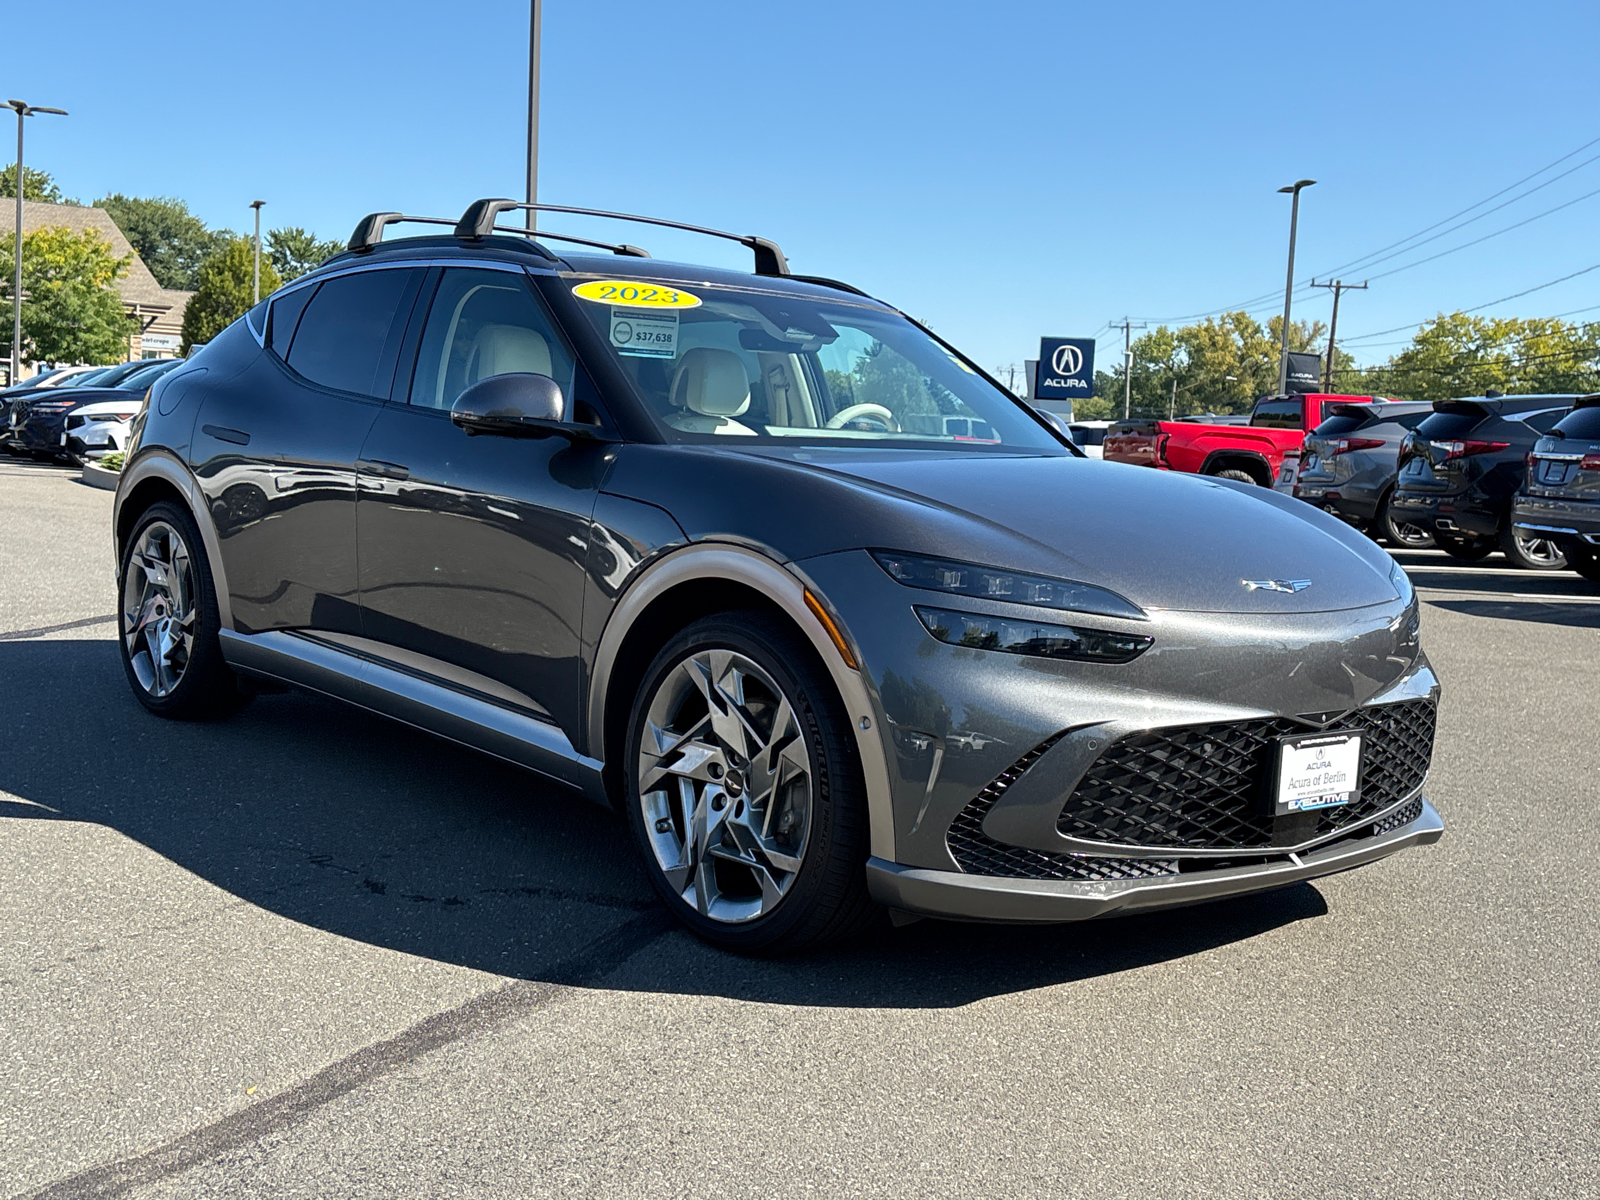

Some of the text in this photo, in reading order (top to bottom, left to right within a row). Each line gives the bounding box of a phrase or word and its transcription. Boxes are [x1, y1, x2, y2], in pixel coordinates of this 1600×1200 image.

[600, 286, 679, 304] 2023
[636, 332, 672, 343] $37,638
[1043, 378, 1088, 389] ACURA
[806, 712, 829, 800] MICHELIN
[1306, 761, 1332, 771] ACURA
[1288, 771, 1346, 789] Acura of Berlin
[1288, 792, 1349, 810] EXECUTIVE
